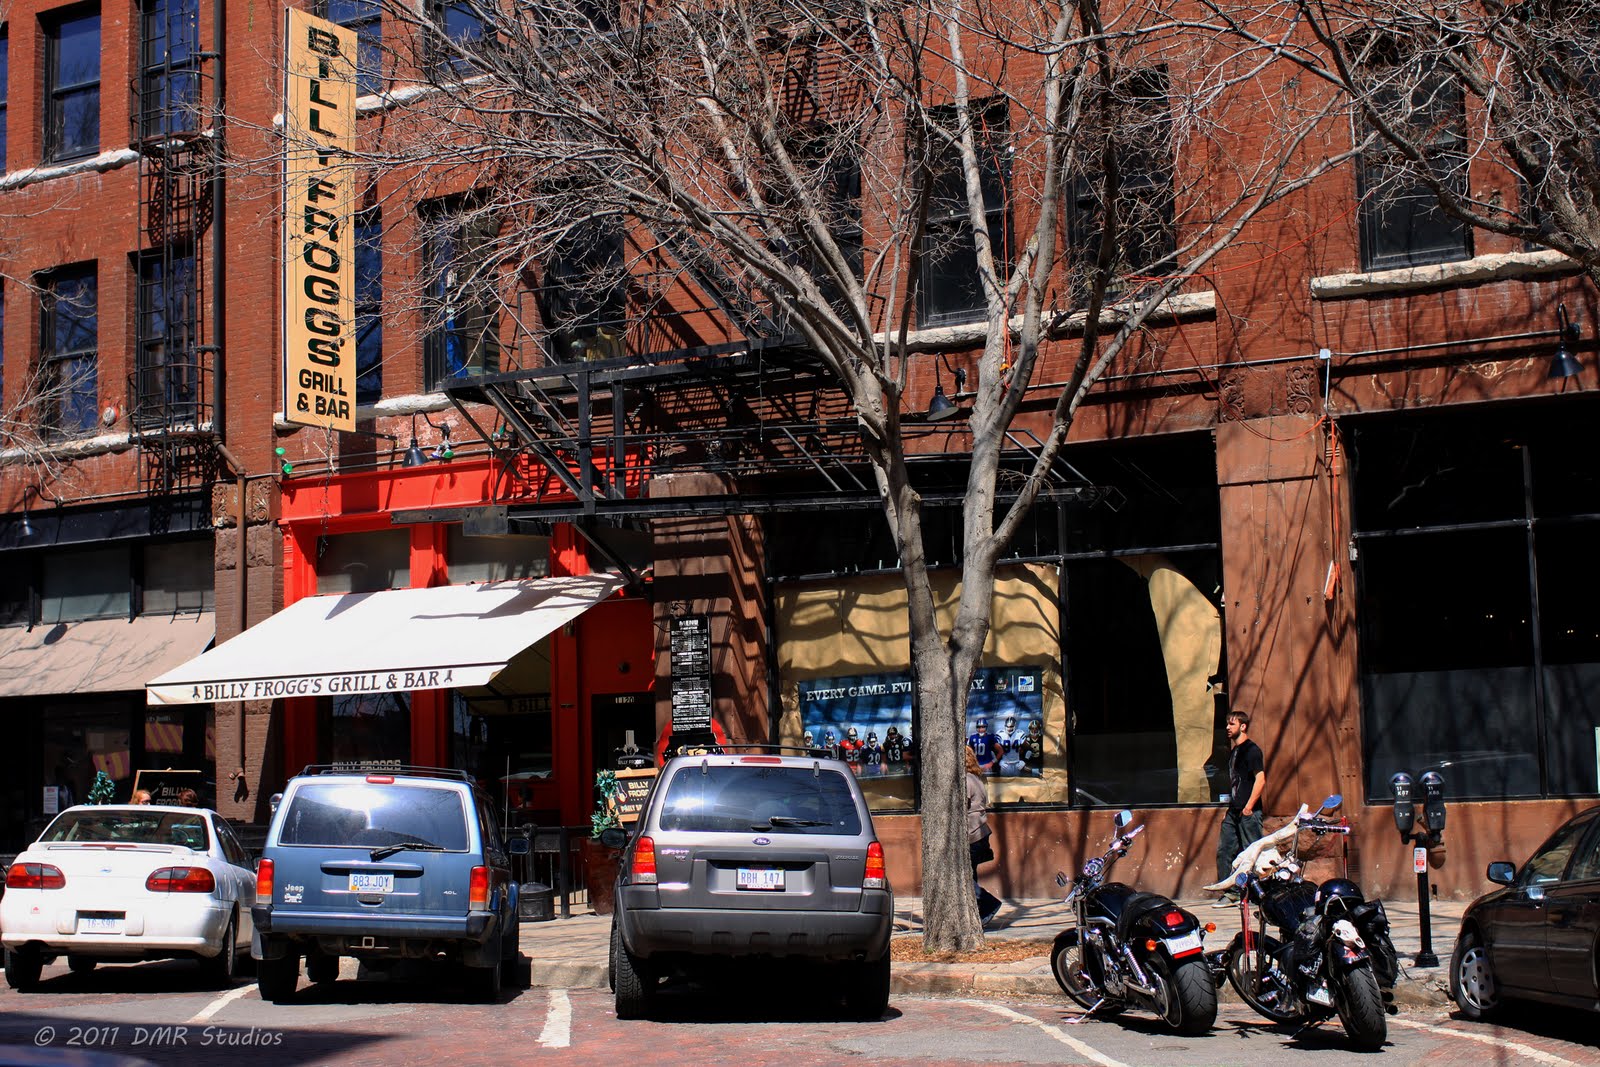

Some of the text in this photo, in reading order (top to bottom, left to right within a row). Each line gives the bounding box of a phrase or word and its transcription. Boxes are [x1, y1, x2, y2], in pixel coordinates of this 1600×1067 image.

[303, 26, 345, 368] BILLY FROGG'S
[299, 368, 347, 397] GRILL
[296, 393, 350, 420] & BAR
[204, 670, 439, 700] BILLY FROGG'S GRILL & BAR
[806, 688, 846, 702] EVERY
[848, 684, 890, 698] GAME.
[845, 749, 860, 762] 52
[888, 748, 901, 761] 43
[974, 743, 986, 756] 10
[867, 752, 881, 765] 20
[628, 781, 649, 790] BILLY
[353, 875, 370, 887] 883
[741, 872, 780, 884] RBH 147
[285, 884, 304, 893] Jeep
